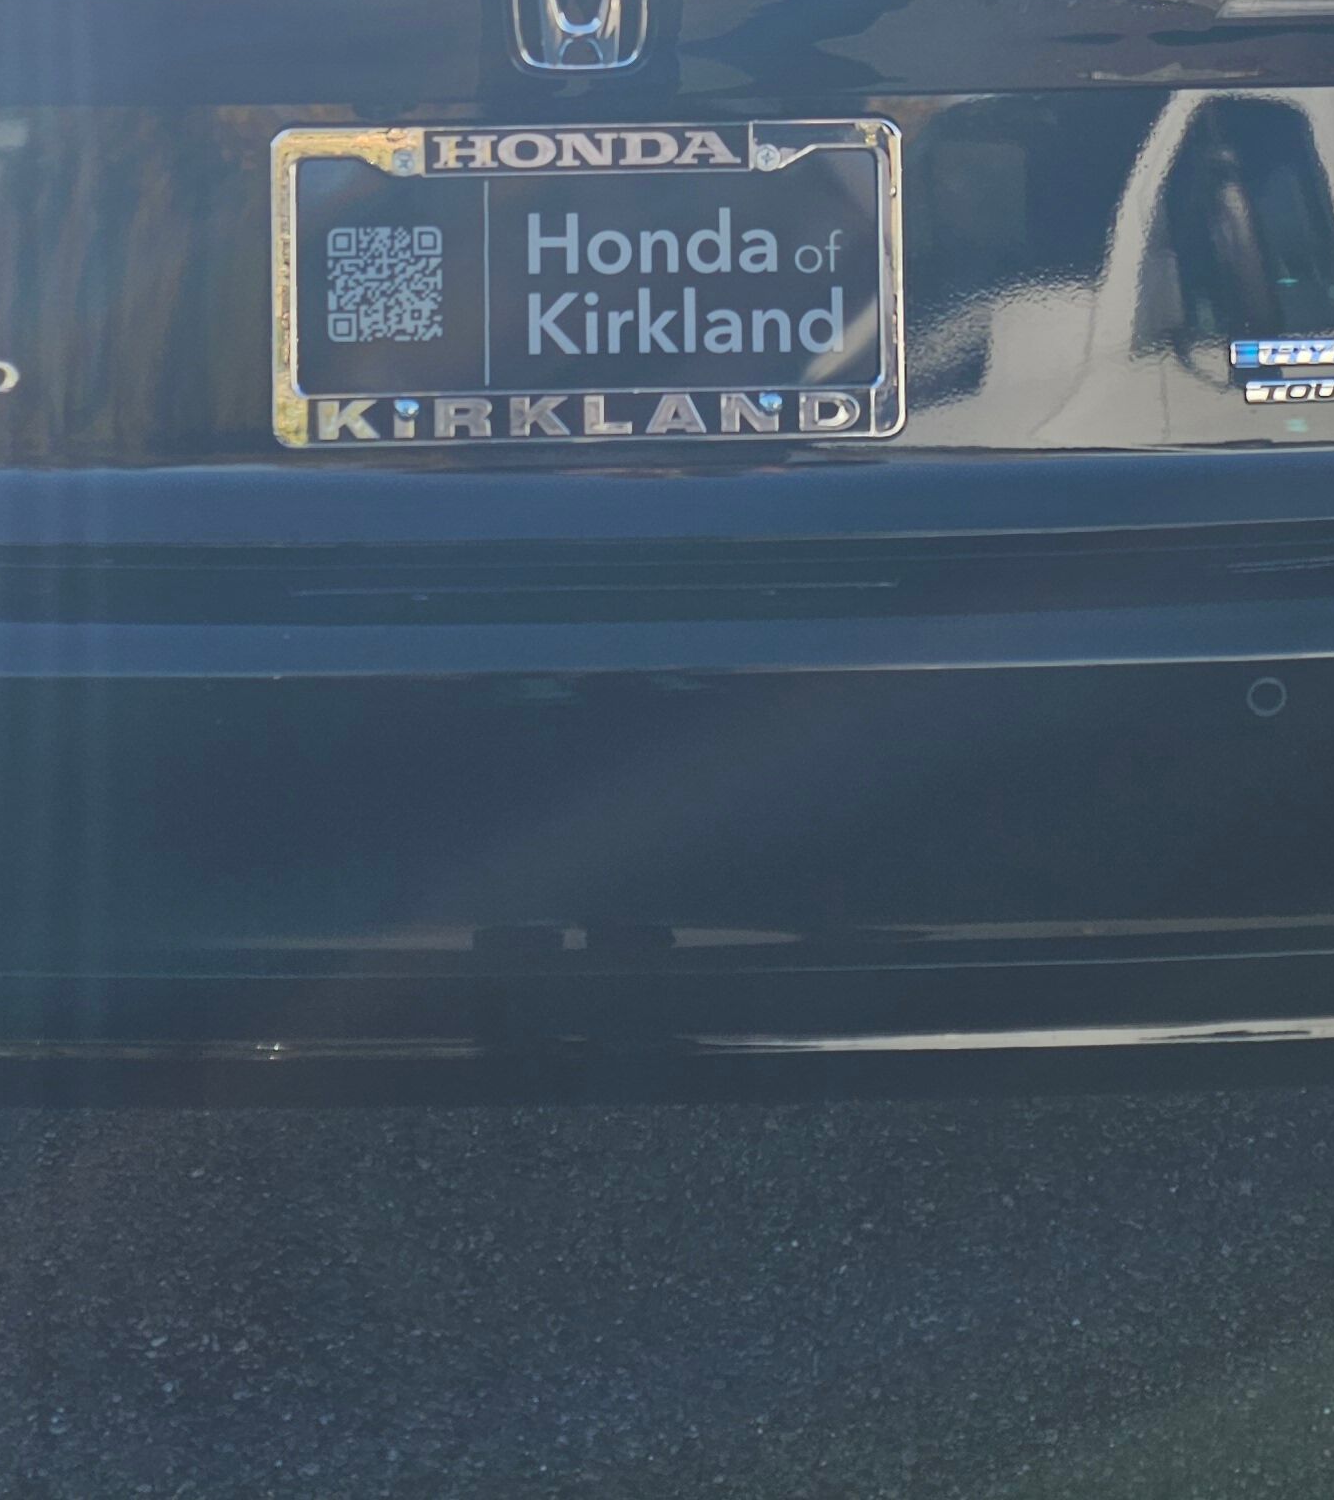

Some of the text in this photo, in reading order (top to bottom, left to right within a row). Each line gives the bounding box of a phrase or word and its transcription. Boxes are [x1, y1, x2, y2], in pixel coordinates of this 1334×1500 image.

[432, 130, 741, 170] HONDA
[527, 207, 844, 276] Honda of
[528, 286, 844, 356] Kirkland
[317, 391, 861, 441] KIRKLAND
